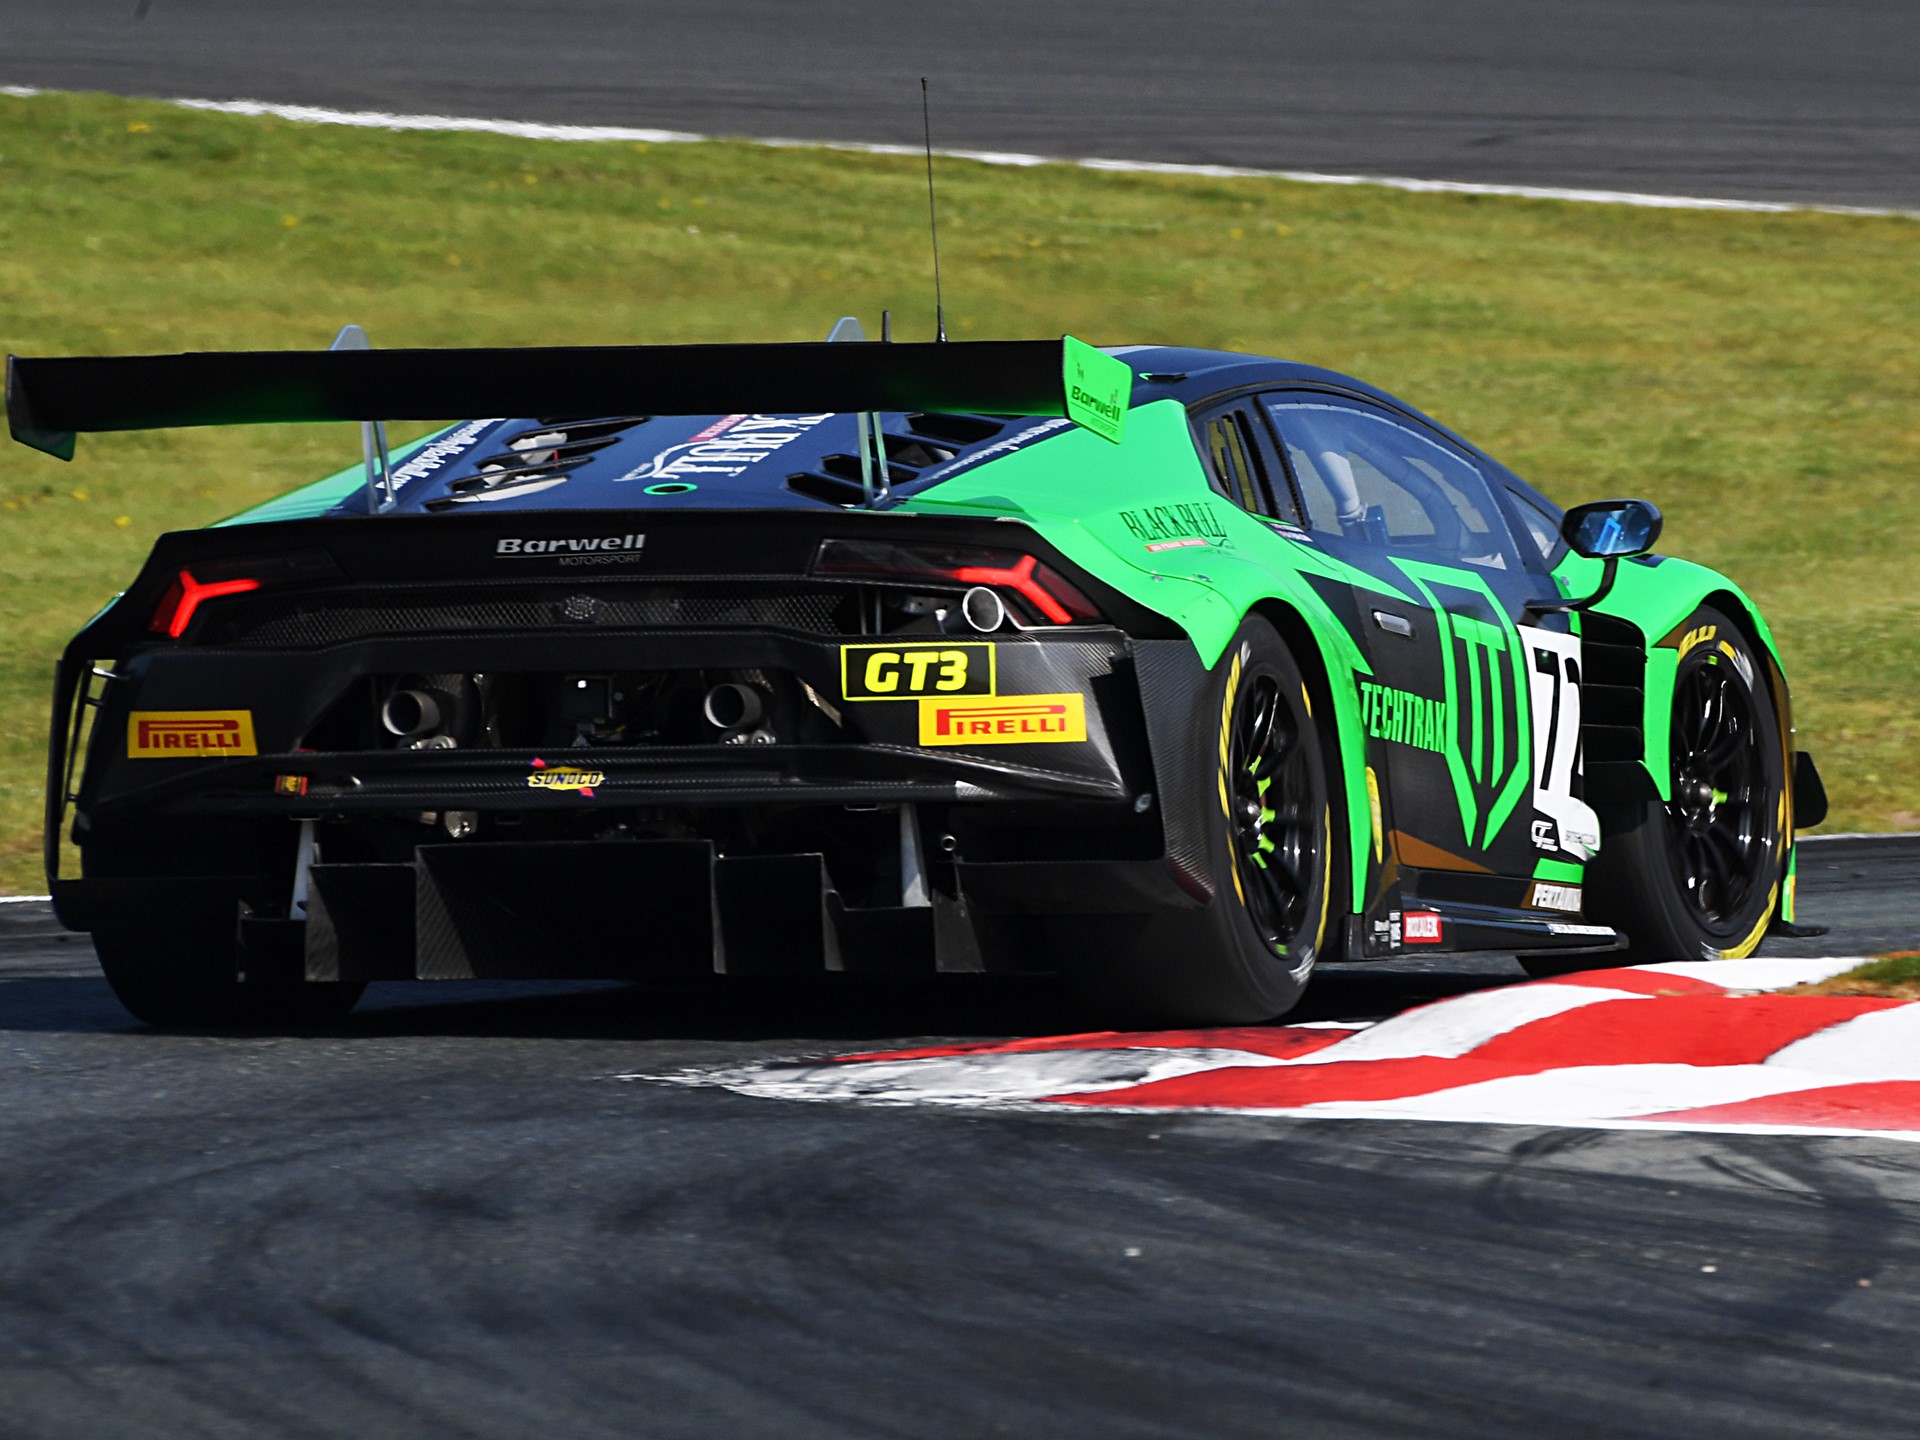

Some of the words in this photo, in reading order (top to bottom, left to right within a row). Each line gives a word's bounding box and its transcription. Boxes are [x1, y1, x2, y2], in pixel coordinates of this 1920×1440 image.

[1071, 385, 1121, 422] Barwell
[496, 534, 645, 553] Barwell
[558, 554, 641, 567] MOTORSPORT
[864, 651, 968, 693] GT3
[936, 704, 1067, 736] PIRELLI
[1360, 681, 1446, 754] TECHTRAK
[138, 719, 242, 749] PIRELLI
[533, 771, 601, 786] SUNOCO
